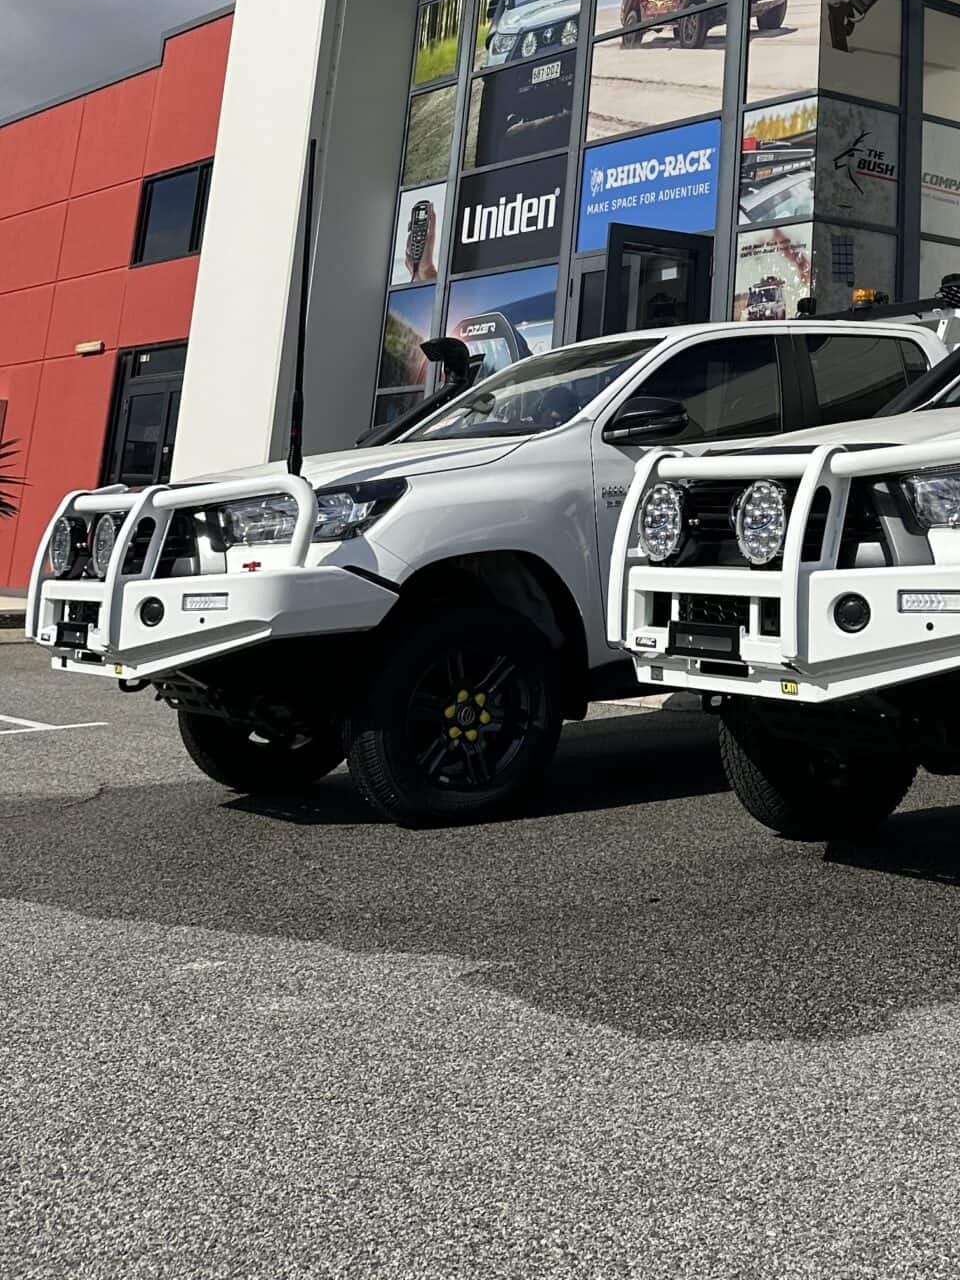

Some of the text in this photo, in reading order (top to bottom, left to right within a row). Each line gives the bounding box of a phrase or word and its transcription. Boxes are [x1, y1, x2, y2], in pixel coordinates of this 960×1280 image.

[605, 148, 713, 189] RHINO-RACK
[857, 159, 895, 177] BUSH
[867, 148, 885, 161] THE
[586, 182, 711, 215] MAKE SPACE FOR ADVENTURE
[461, 192, 556, 244] Uniden
